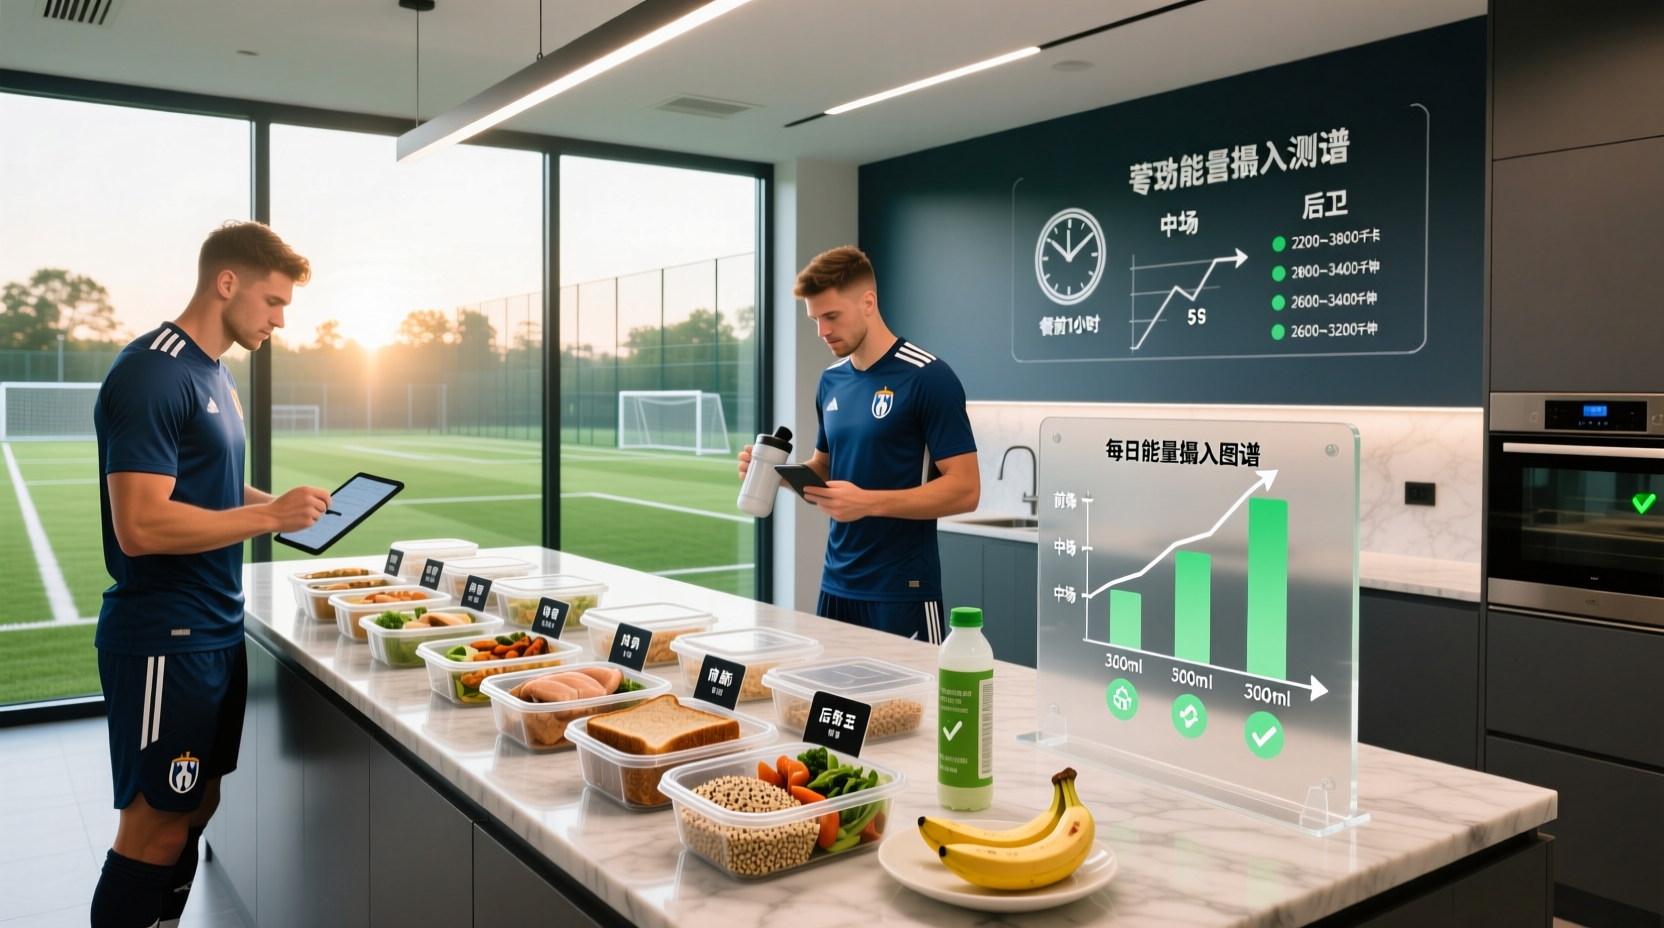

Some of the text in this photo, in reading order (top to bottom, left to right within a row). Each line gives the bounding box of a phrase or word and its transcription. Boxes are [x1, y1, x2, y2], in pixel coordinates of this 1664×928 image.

[1302, 189, 1349, 220] 后卫
[1160, 210, 1199, 238] 中场
[1171, 667, 1213, 690] 500ml
